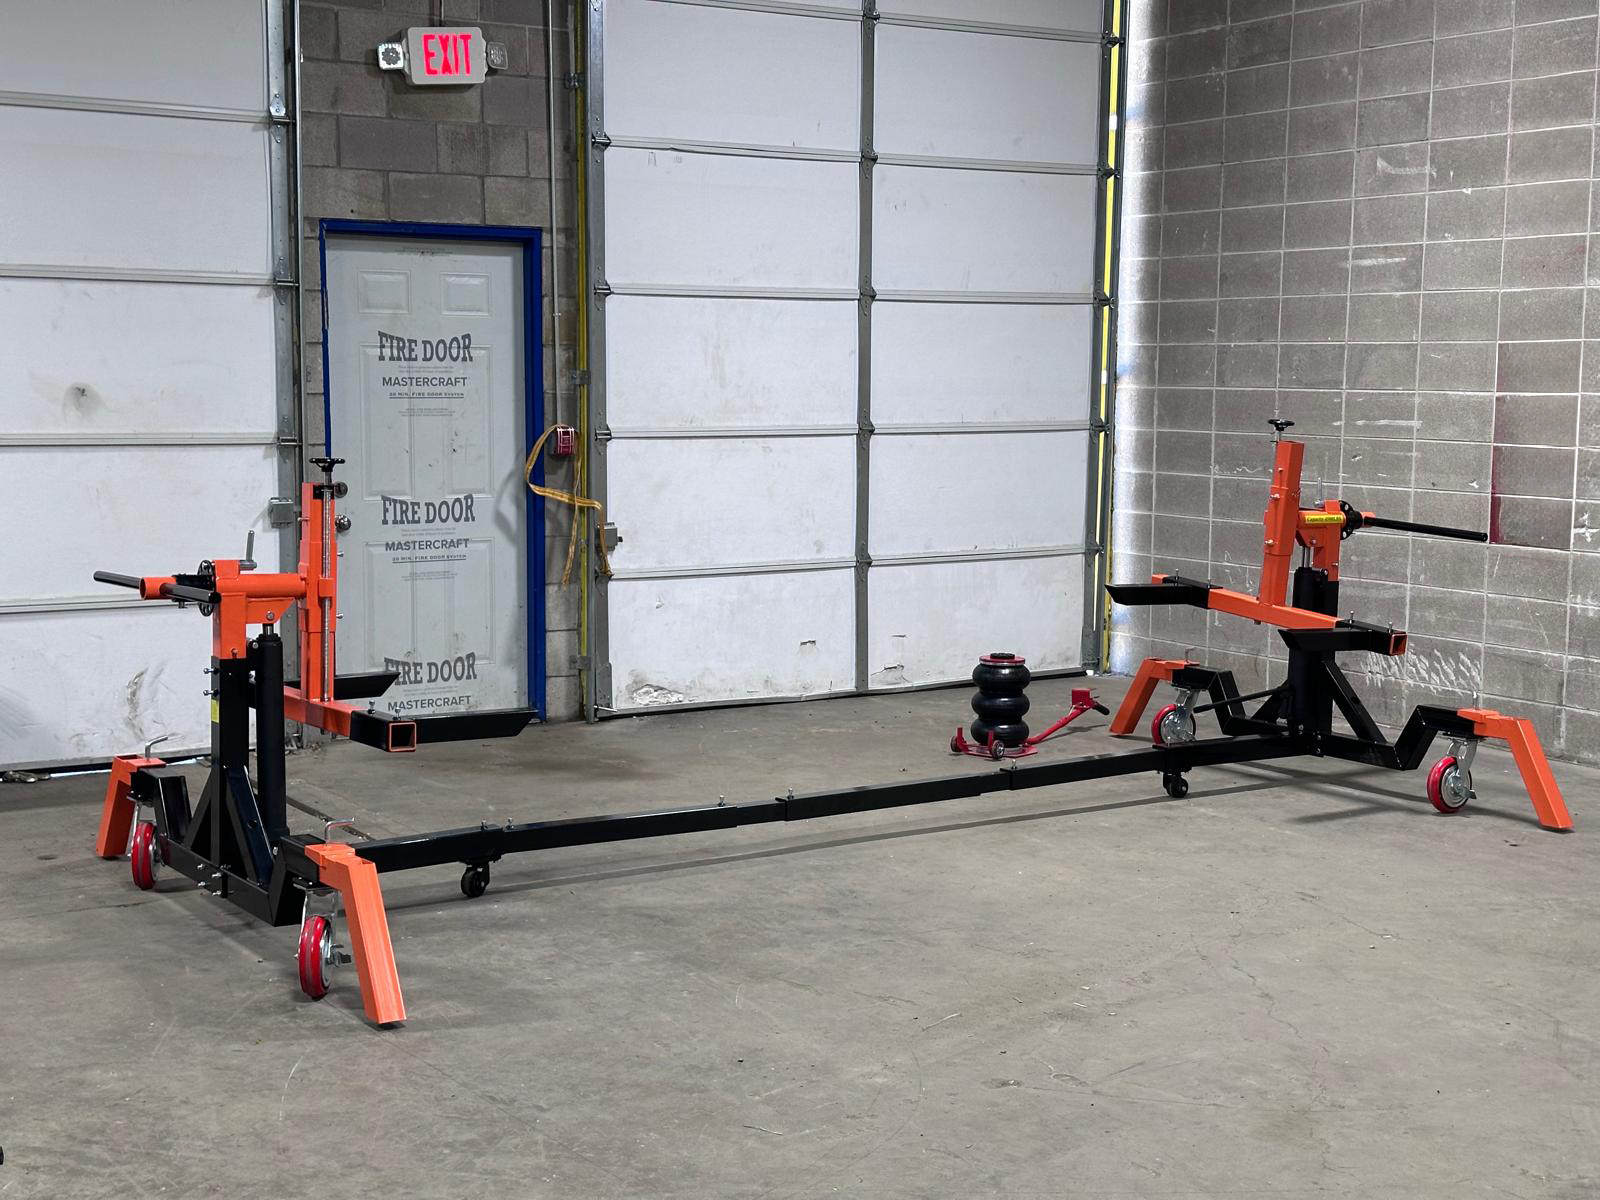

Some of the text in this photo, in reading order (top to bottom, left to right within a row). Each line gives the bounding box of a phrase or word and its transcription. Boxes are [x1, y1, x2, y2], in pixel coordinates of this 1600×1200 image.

[422, 34, 472, 76] EXIT
[378, 330, 473, 362] FIRE DOOR
[382, 376, 467, 387] MASTERCRAFT
[381, 493, 475, 525] FIRE DOOR
[385, 538, 469, 551] MASTERCRAFT
[426, 651, 477, 683] DOOR
[388, 695, 471, 711] MASTERCRAFT
